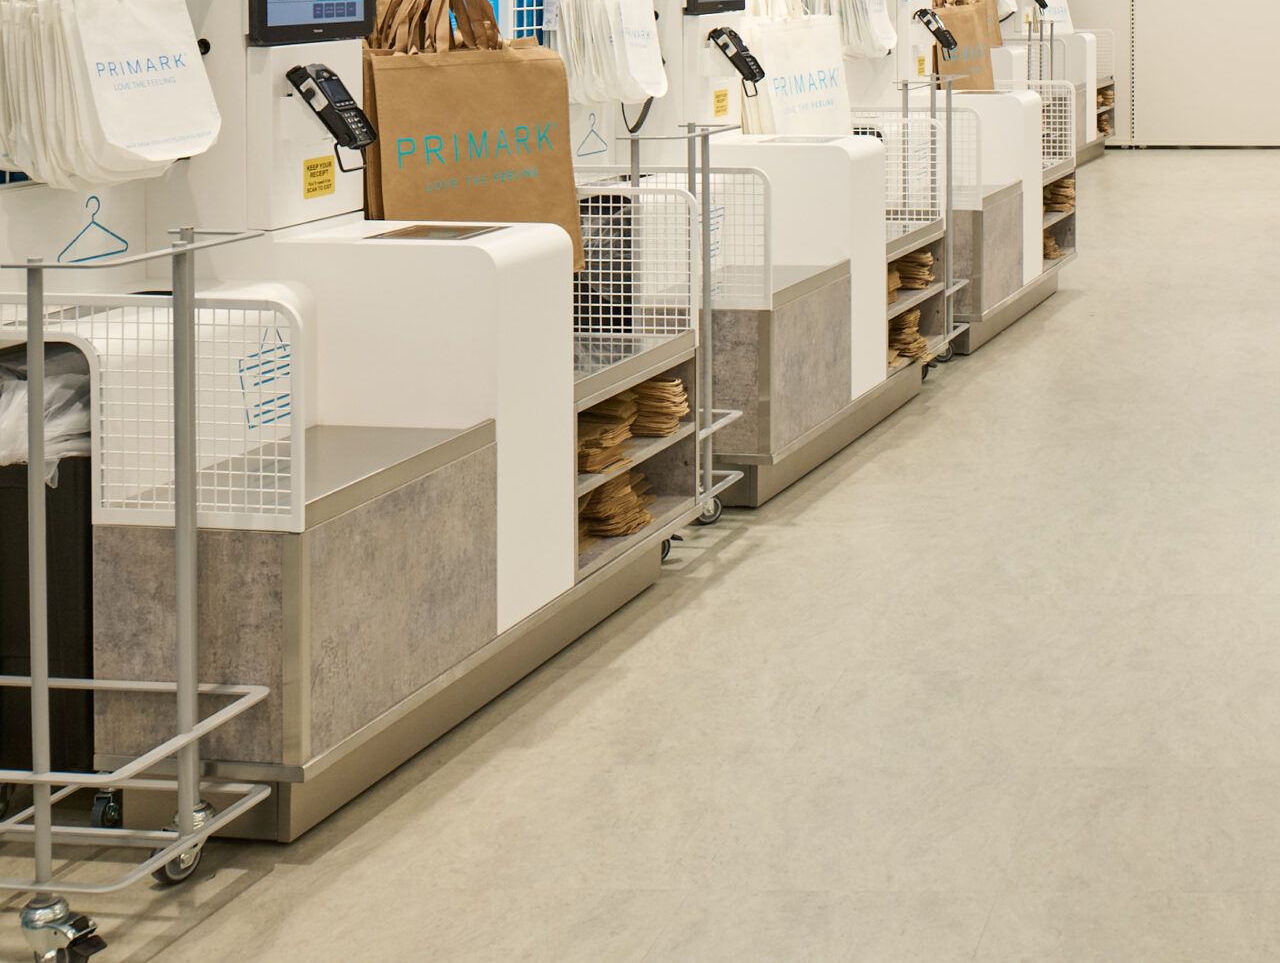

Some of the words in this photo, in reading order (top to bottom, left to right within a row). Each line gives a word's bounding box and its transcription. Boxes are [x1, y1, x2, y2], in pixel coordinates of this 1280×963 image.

[95, 53, 187, 78] PRIMARK
[146, 76, 177, 87] FEELING
[773, 68, 839, 98] PRIMARK
[396, 122, 555, 169] PRIMARK
[307, 163, 319, 171] KEEP
[319, 161, 332, 169] YOUR
[310, 169, 329, 178] RECEIPT
[426, 178, 459, 193] LOVE
[466, 174, 489, 188] THE
[493, 167, 539, 183] FEELING
